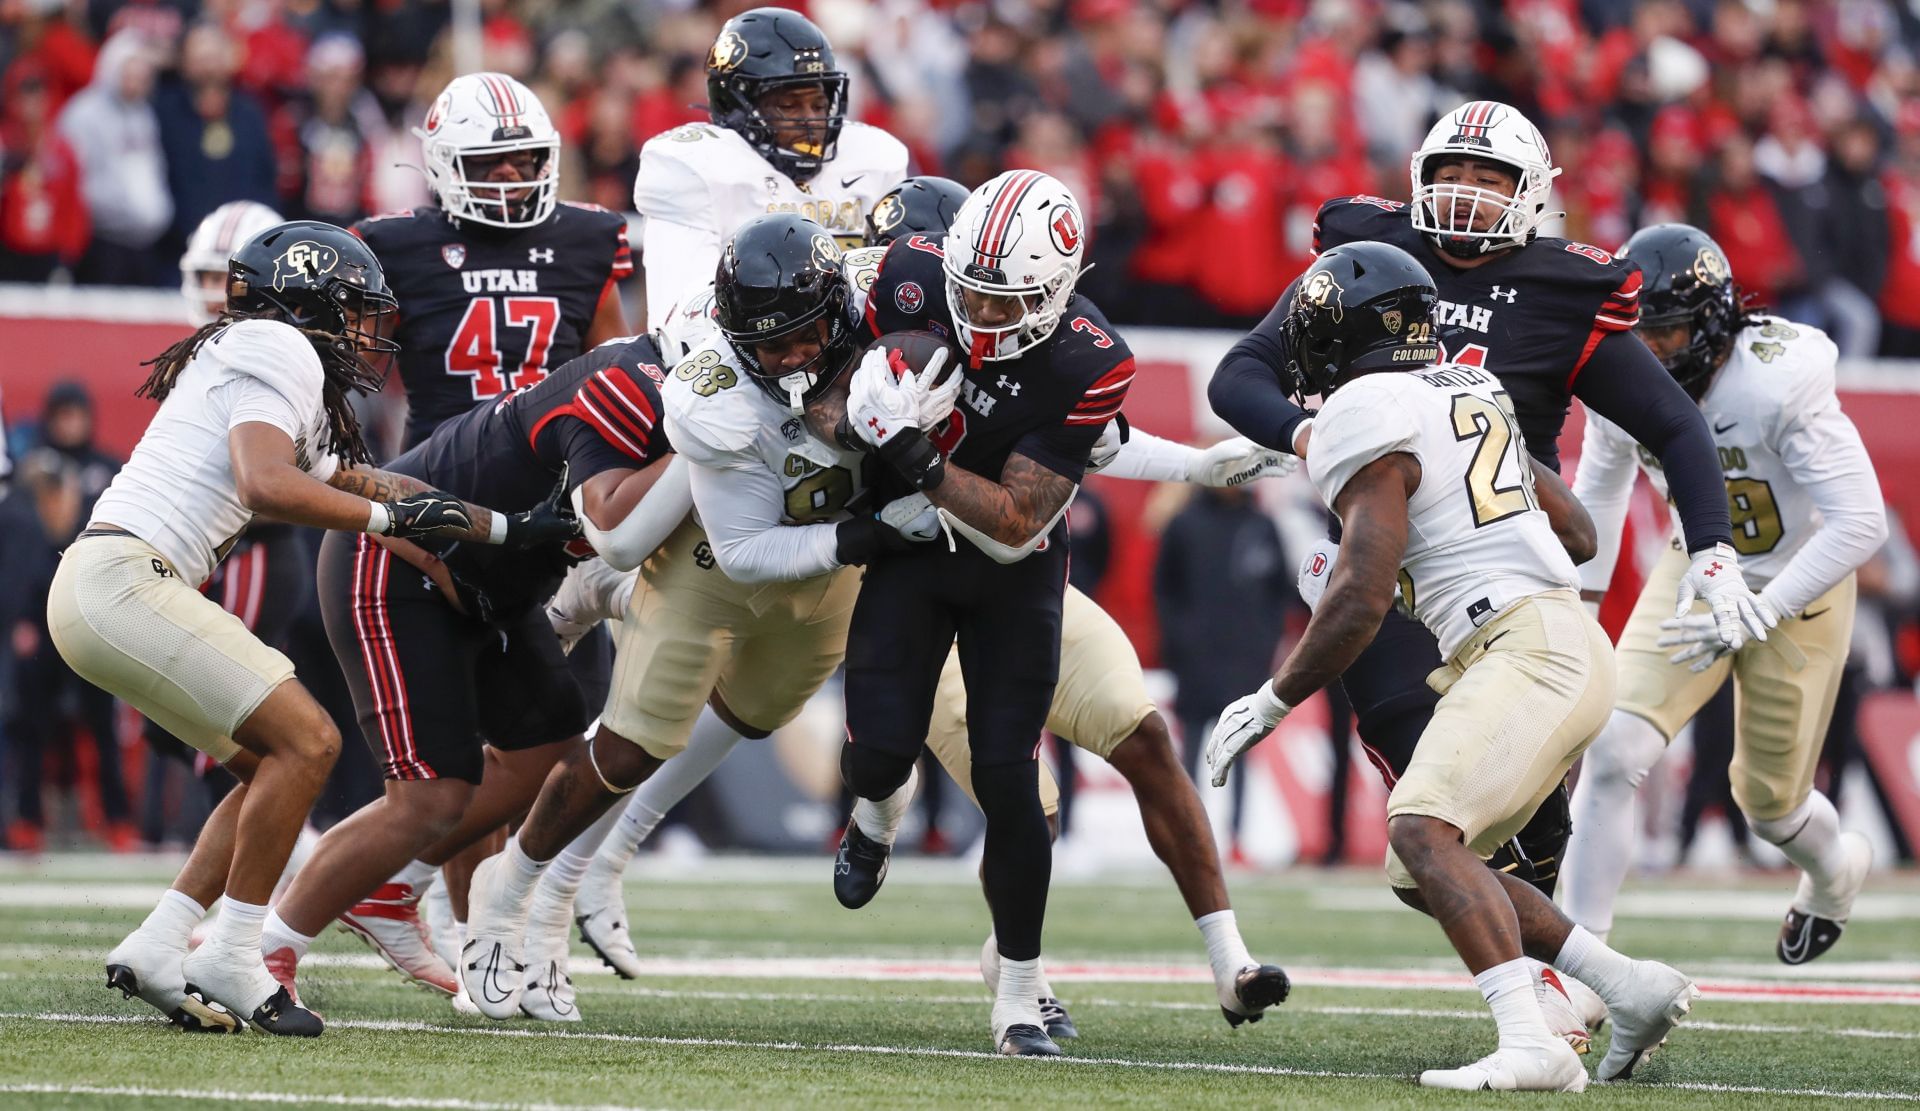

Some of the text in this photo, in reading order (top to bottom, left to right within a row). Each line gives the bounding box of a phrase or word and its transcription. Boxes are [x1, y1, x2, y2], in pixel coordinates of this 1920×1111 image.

[461, 269, 538, 293] UTAH
[1070, 316, 1114, 349] 3
[1406, 322, 1430, 344] 20
[1437, 299, 1494, 334] TAH
[444, 297, 562, 401] 47
[1392, 348, 1438, 361] COLORADO
[675, 349, 738, 397] 88
[961, 377, 998, 418] AH
[1724, 476, 1785, 556] 9
